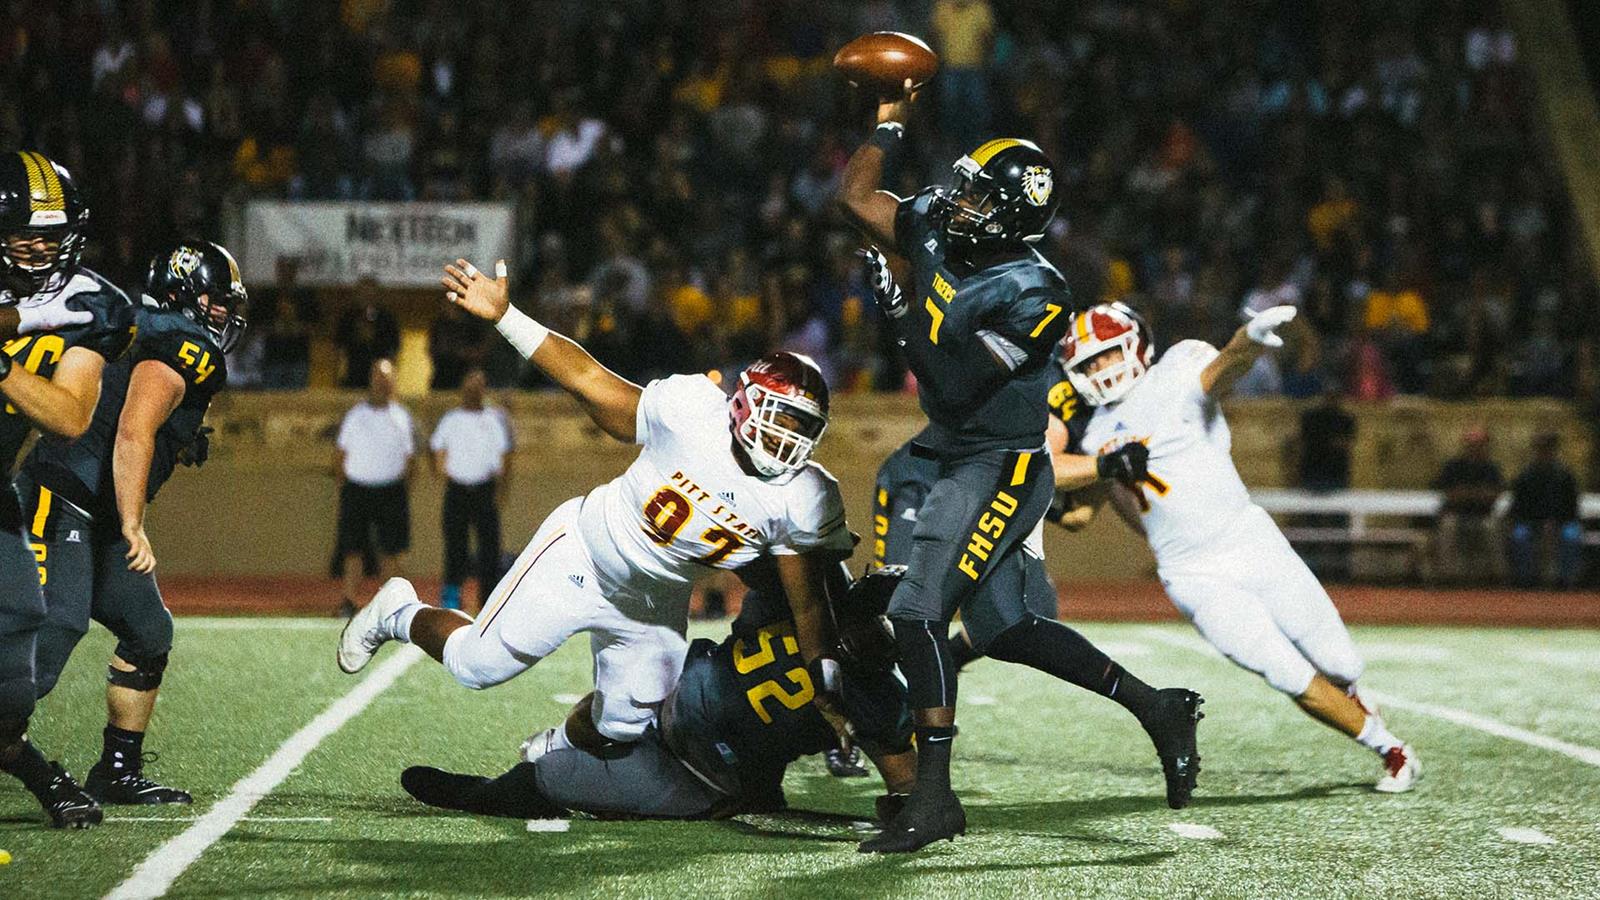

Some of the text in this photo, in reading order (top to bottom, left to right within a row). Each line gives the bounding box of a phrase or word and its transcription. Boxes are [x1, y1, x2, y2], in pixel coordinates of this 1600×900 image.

[931, 272, 957, 304] TIGERS
[924, 296, 945, 345] 7
[1029, 303, 1062, 338] 7
[178, 340, 216, 384] 54
[671, 470, 711, 502] PITT
[639, 485, 745, 566] 97
[958, 490, 1018, 581] FHSU
[733, 622, 815, 725] 52
